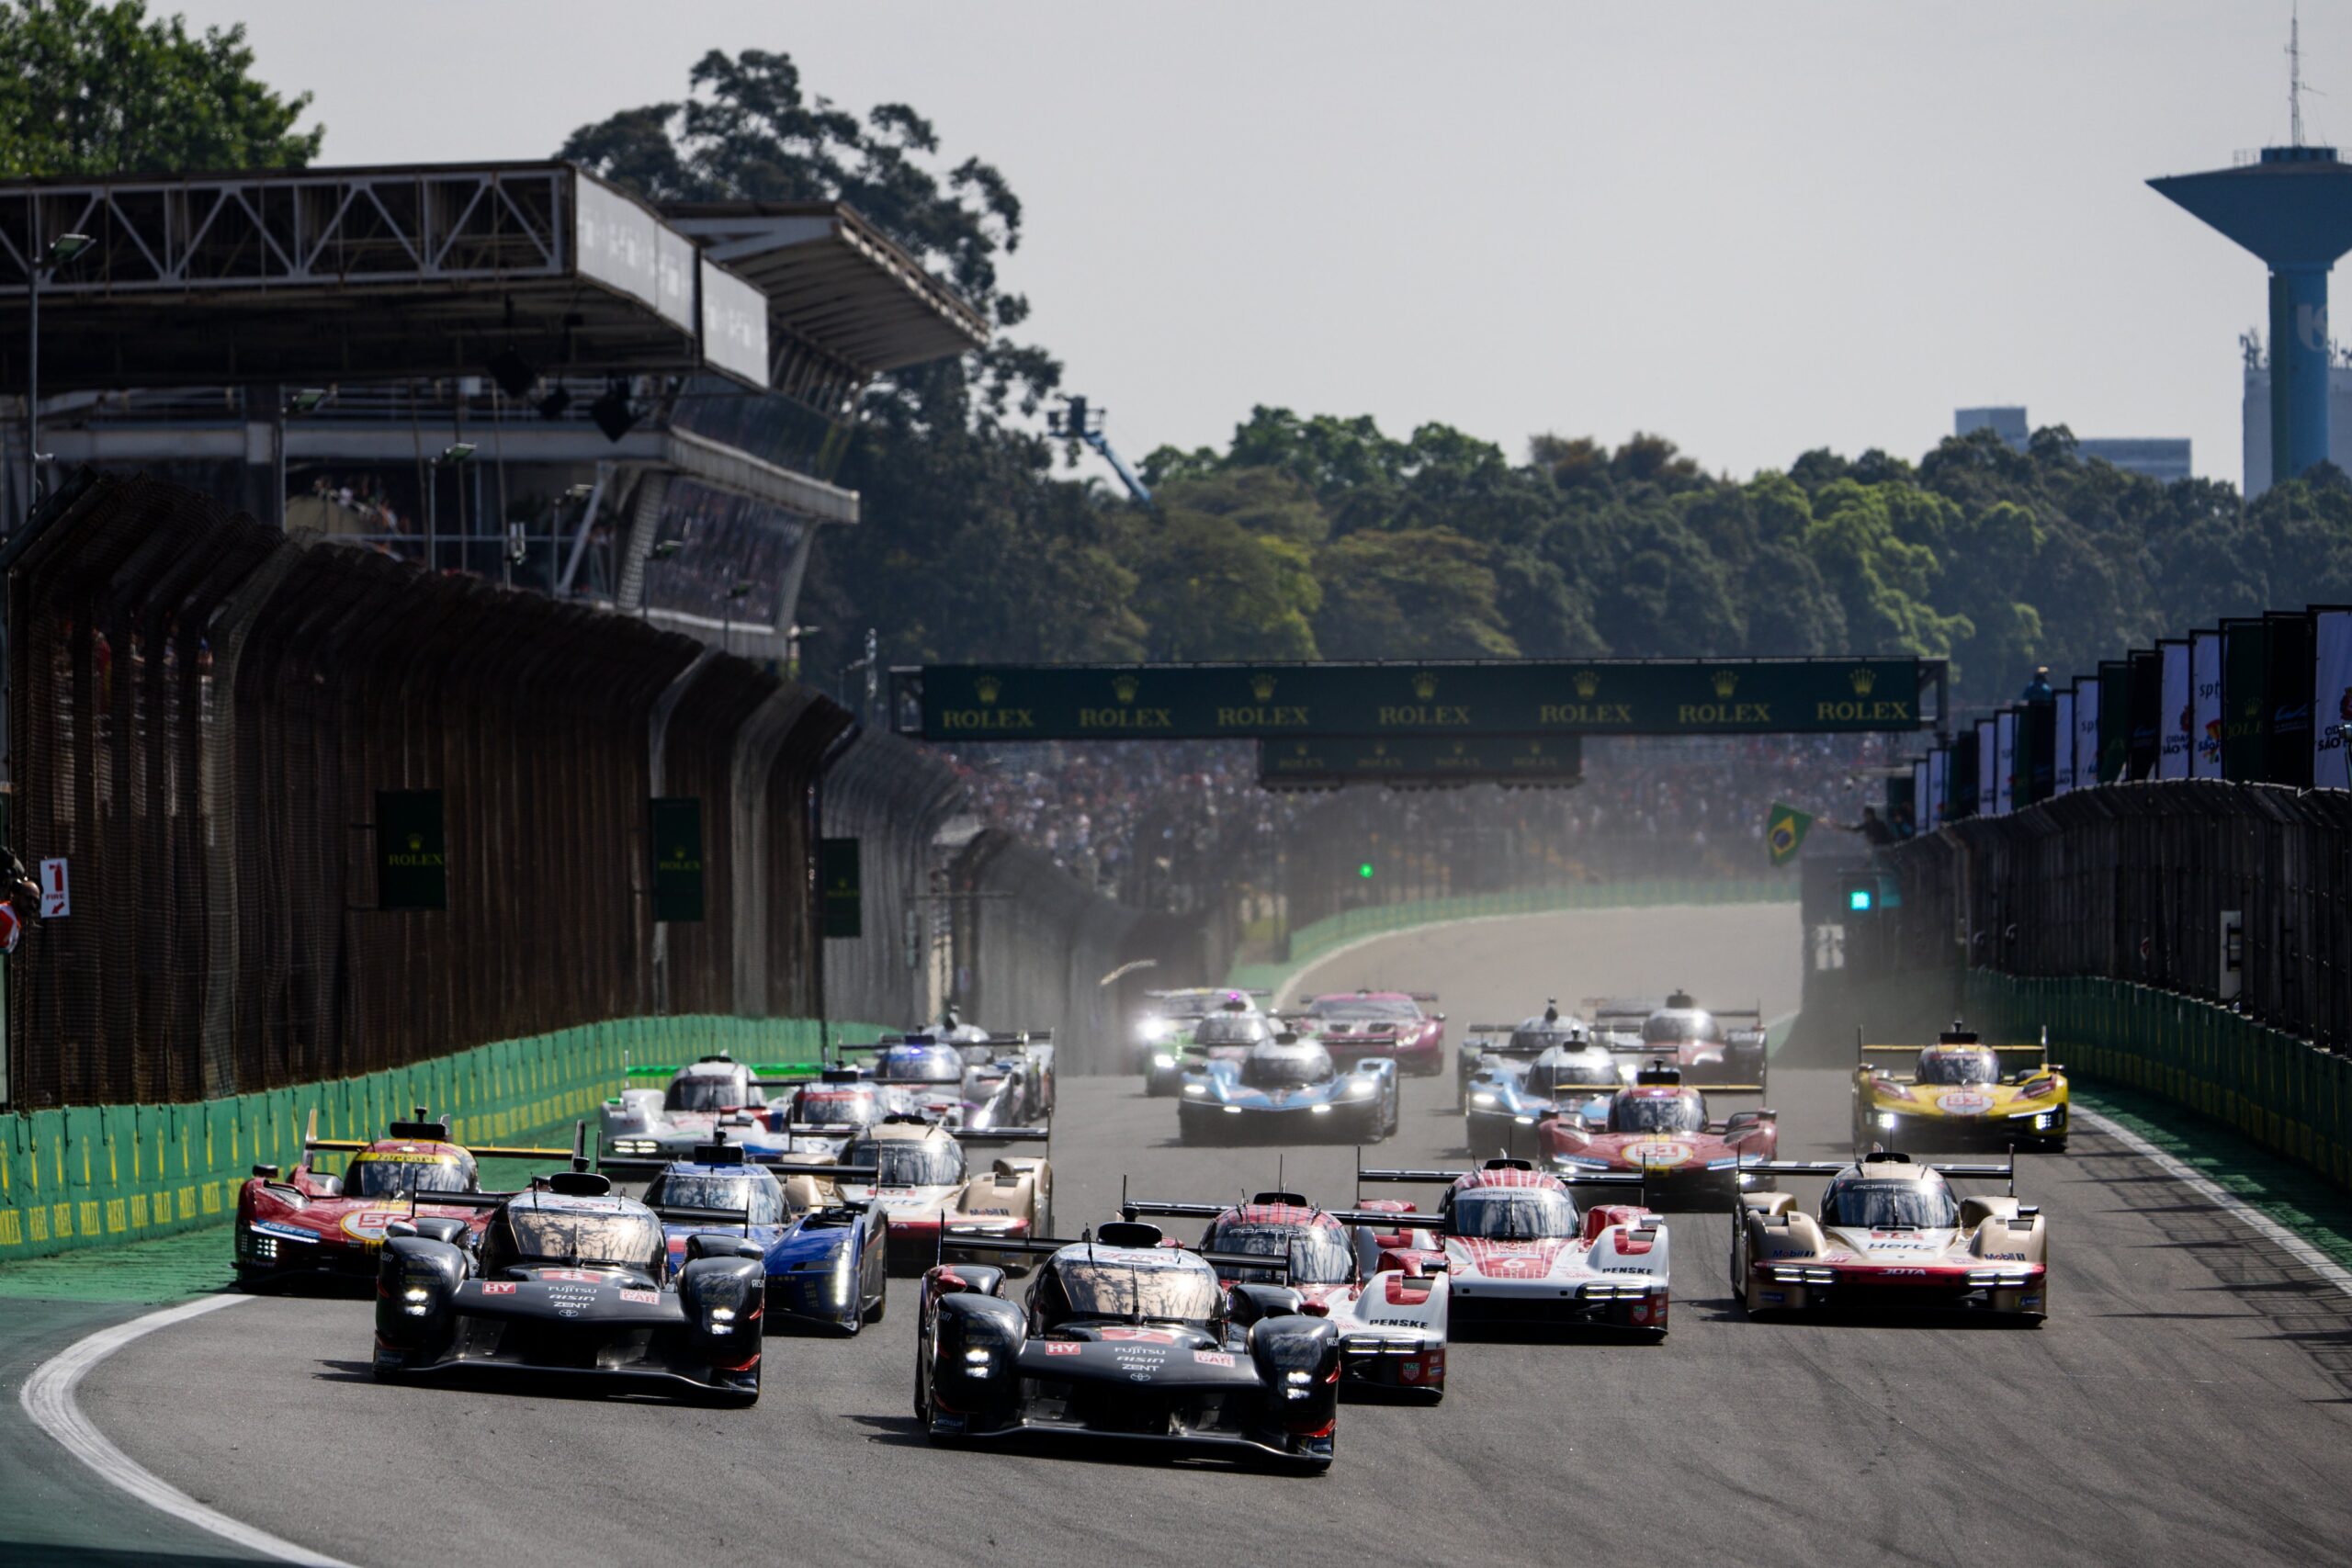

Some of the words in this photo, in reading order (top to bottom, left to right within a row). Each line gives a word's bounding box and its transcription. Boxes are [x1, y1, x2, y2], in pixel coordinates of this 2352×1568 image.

[1217, 706, 1308, 726] ROLEX
[1379, 705, 1470, 725] ROLEX
[1540, 705, 1632, 723] ROLEX
[1679, 704, 1770, 722] ROLEX
[1816, 701, 1908, 721] ROLEX
[943, 709, 1035, 729] ROLEX
[1080, 708, 1171, 728] ROLEX
[2324, 725, 2339, 736] CID
[388, 853, 443, 866] ROLEX
[1640, 1146, 1676, 1156] 51
[378, 1153, 436, 1163] Ferrari
[260, 1221, 296, 1234] ADLER
[1772, 1249, 1804, 1258] Mobil
[1984, 1252, 2015, 1261] Mobil
[1502, 1258, 1526, 1269] 6
[560, 1271, 583, 1280] 8
[1601, 1267, 1655, 1276] PENSKE
[1878, 1268, 1927, 1276] JOTA
[483, 1284, 512, 1293] HY
[548, 1286, 597, 1294] FUJITSU
[624, 1293, 656, 1303] CAR
[553, 1301, 590, 1309] ZENT
[1369, 1318, 1430, 1330] PENSKE
[1047, 1344, 1074, 1353] HY
[1114, 1347, 1166, 1356] FUJITSU
[1198, 1355, 1231, 1366] CAR
[1122, 1363, 1159, 1371] ZENT
